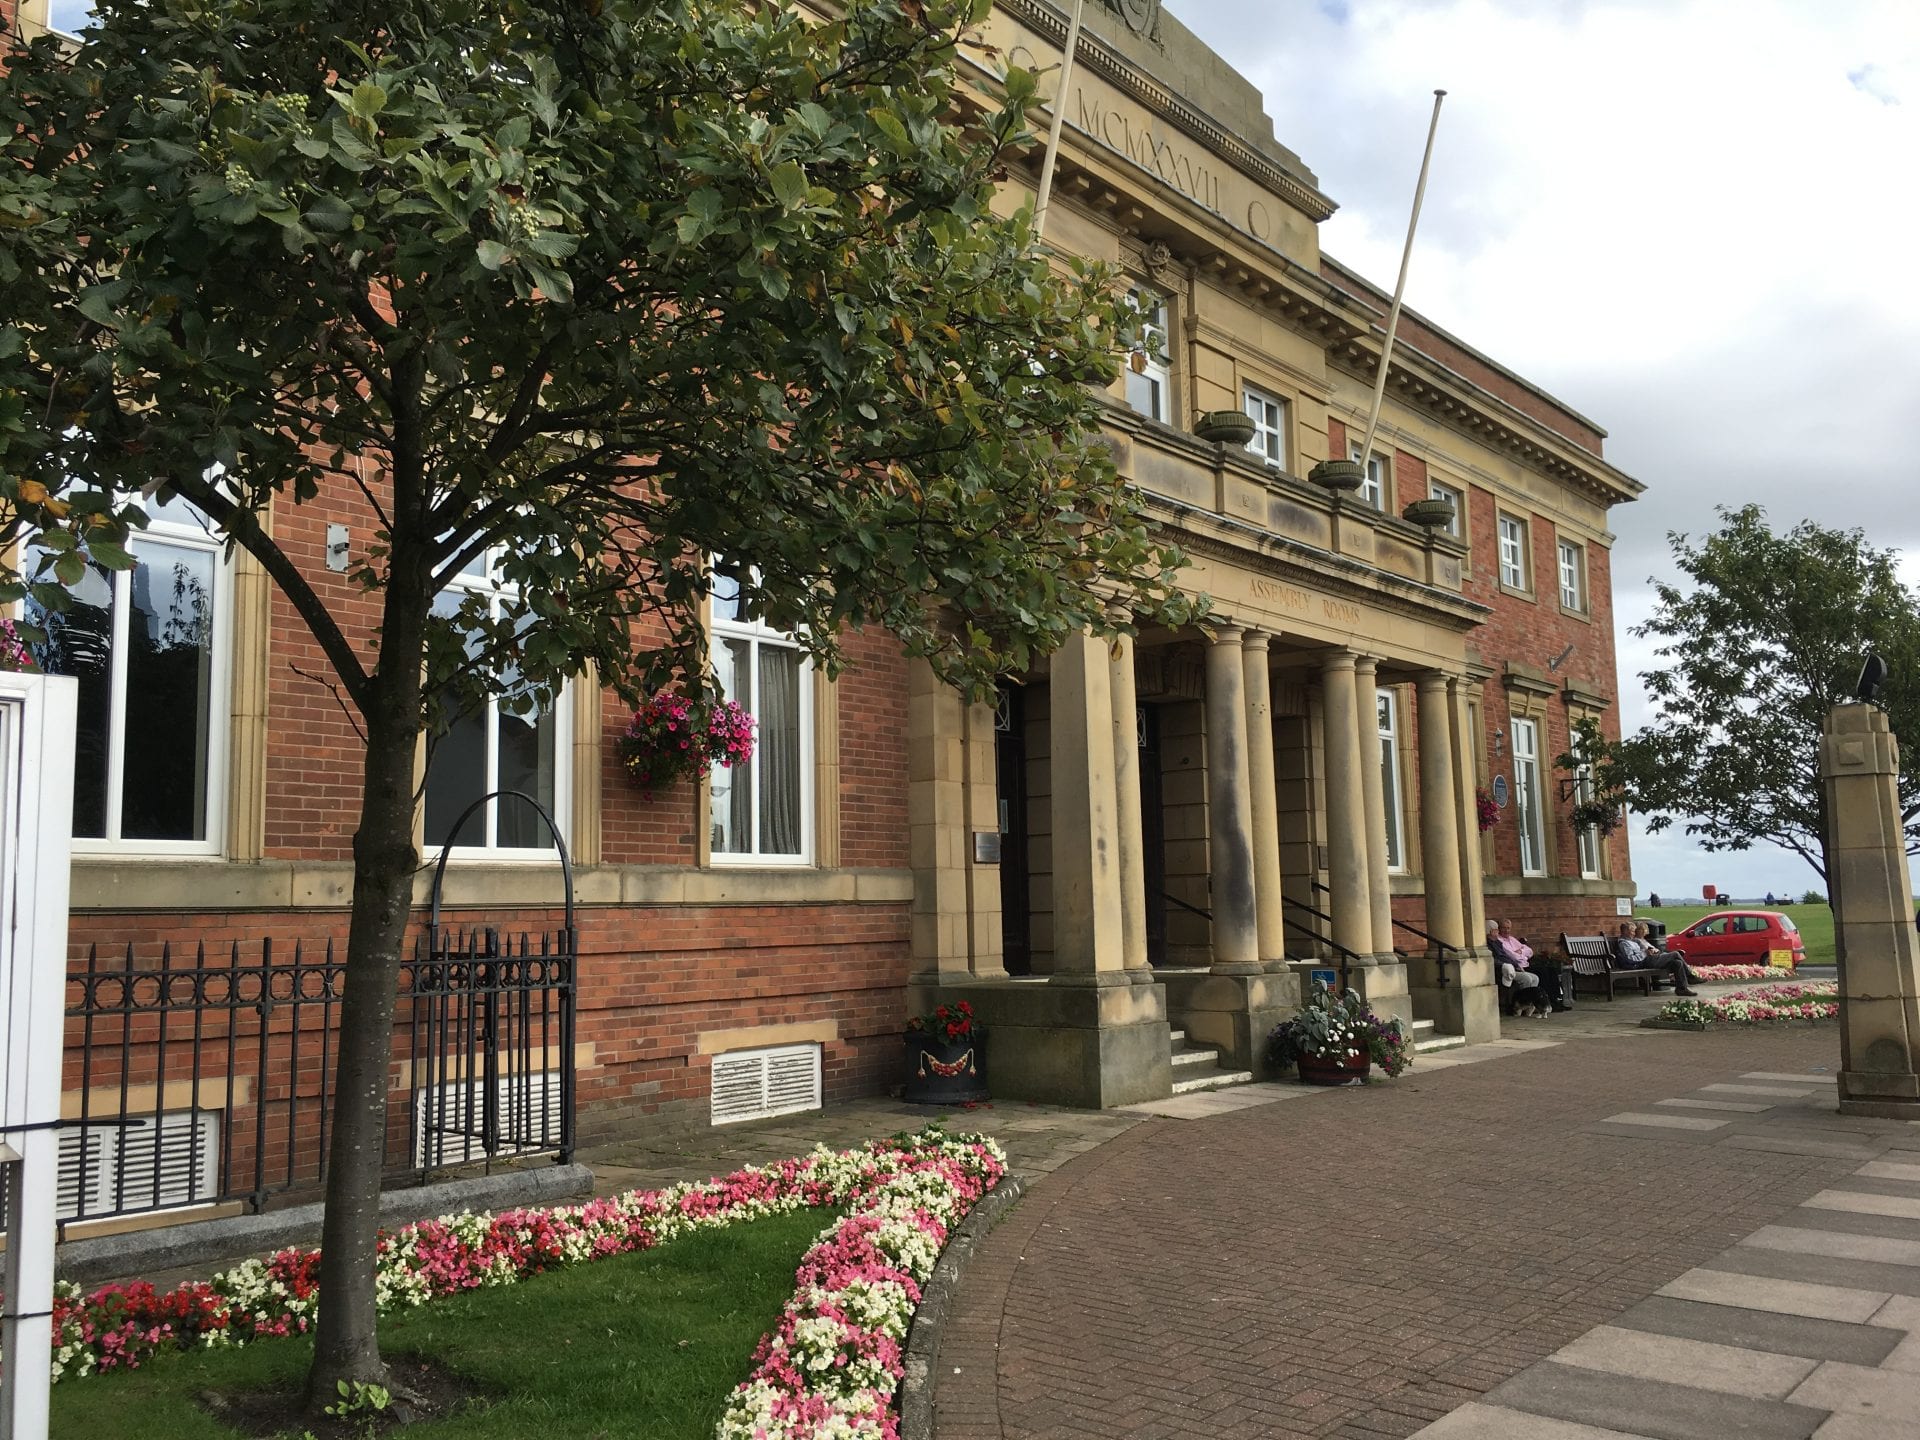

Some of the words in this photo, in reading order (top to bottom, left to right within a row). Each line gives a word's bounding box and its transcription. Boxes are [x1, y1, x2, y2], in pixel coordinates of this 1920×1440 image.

[1078, 87, 1220, 214] MCMXXVII
[1249, 578, 1311, 612] ASSEMBLY
[1322, 599, 1360, 625] ROOMS
